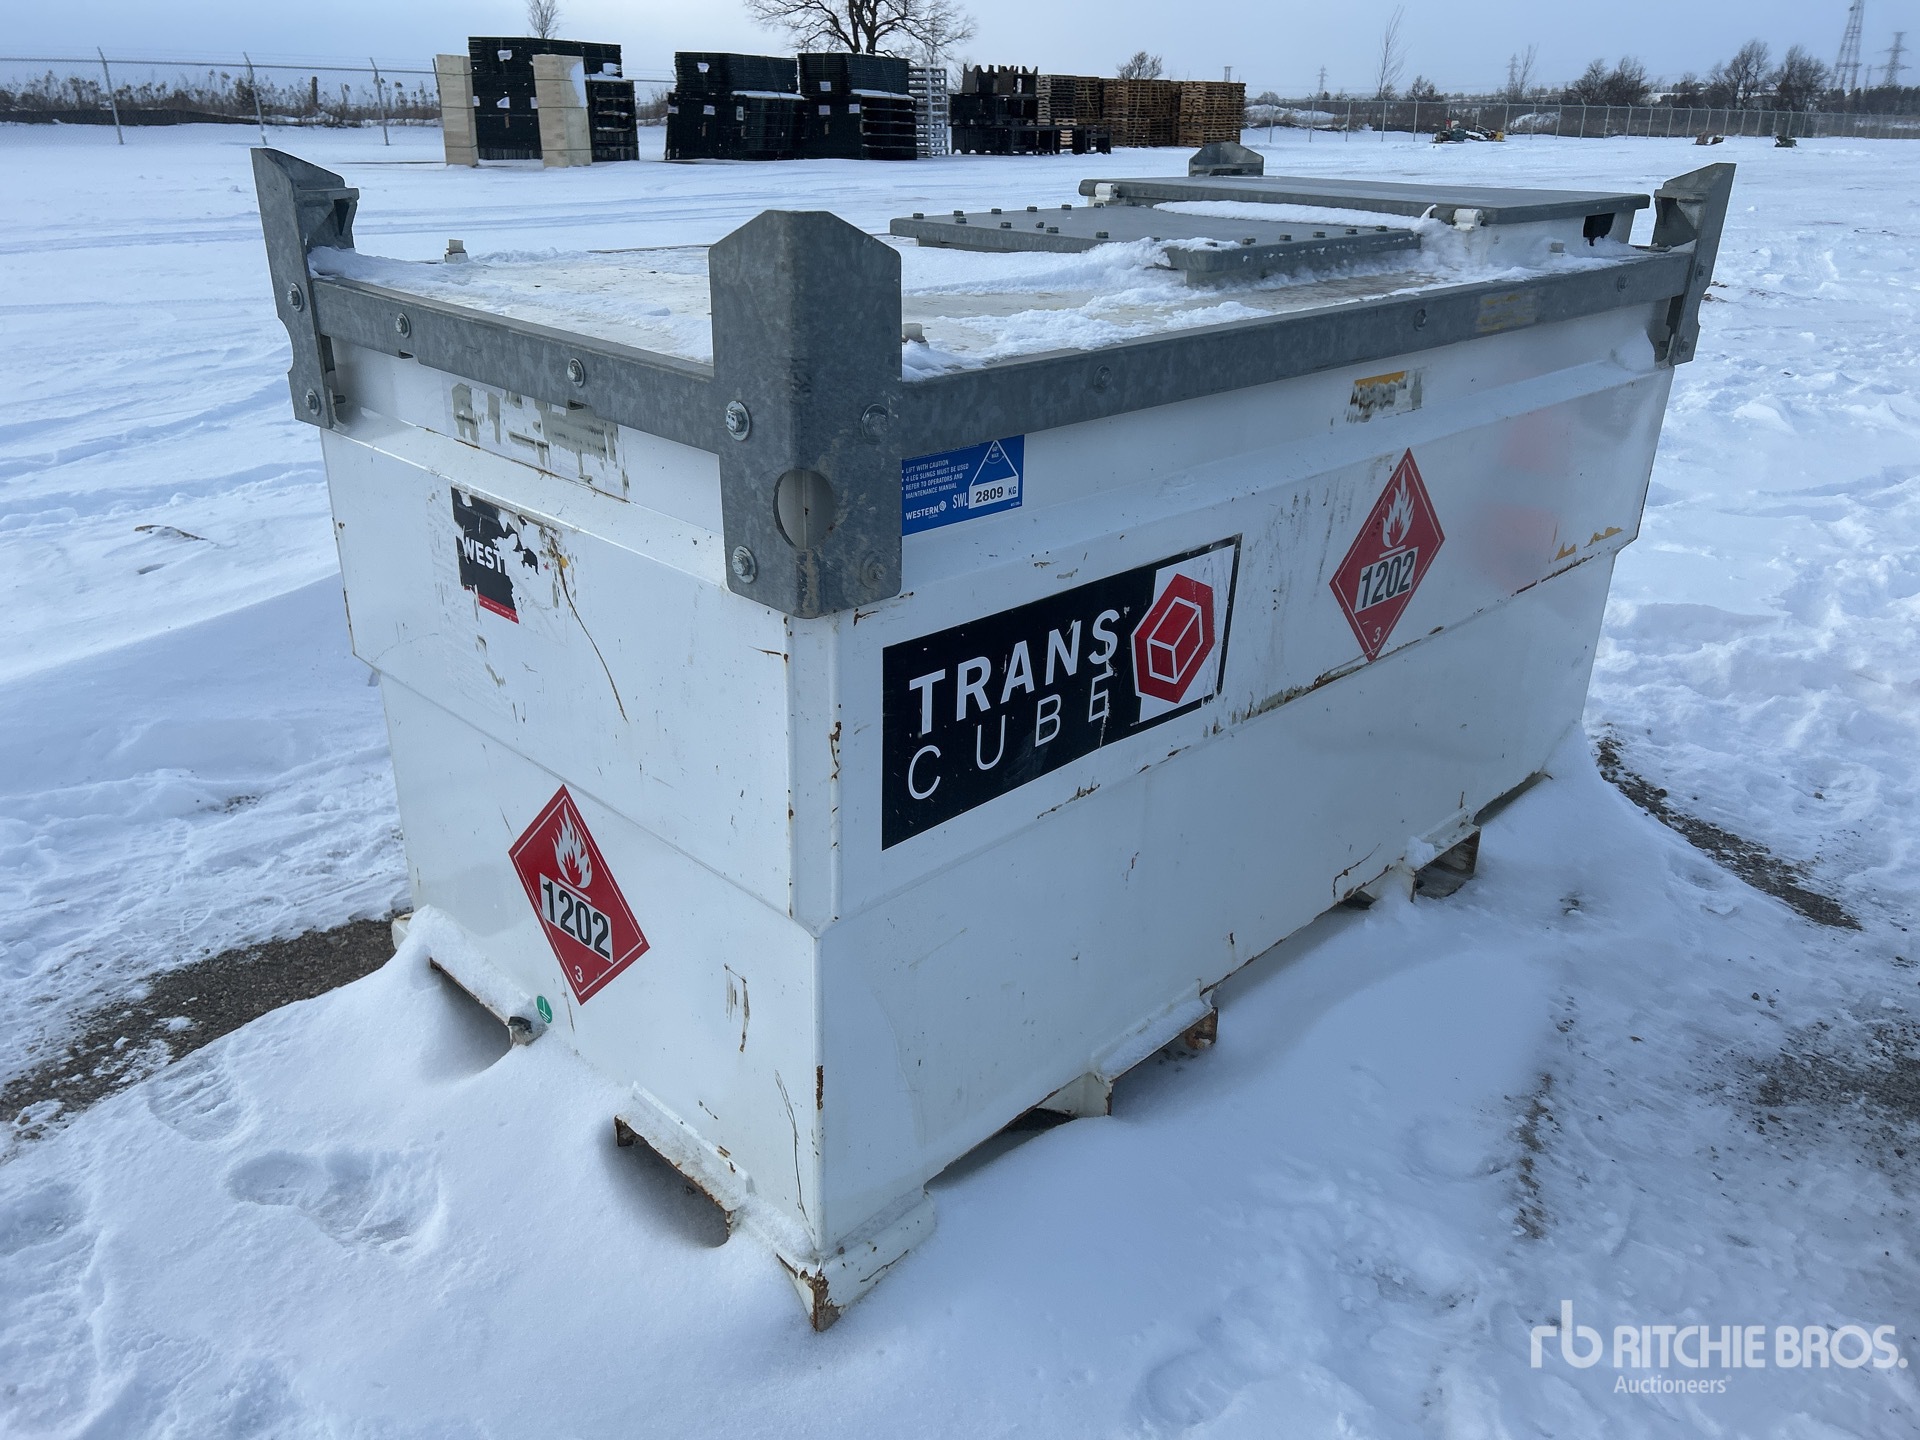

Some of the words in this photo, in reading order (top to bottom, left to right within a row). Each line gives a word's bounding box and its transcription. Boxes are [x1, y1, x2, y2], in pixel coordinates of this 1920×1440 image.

[910, 474, 919, 482] LEG
[920, 471, 936, 480] SLINGS
[937, 468, 950, 476] MUST
[957, 463, 970, 471] USED
[916, 464, 929, 472] WITH
[929, 460, 949, 468] CAUTION
[905, 482, 920, 491] REFER
[921, 480, 927, 488] TO
[928, 475, 953, 486] OPERATORS
[953, 472, 964, 481] AND
[905, 487, 938, 499] MAINTENANCE
[938, 482, 957, 492] MANUAL
[953, 492, 968, 508] SWL
[975, 486, 1004, 504] 2809
[1008, 485, 1017, 496] KG
[905, 505, 939, 520] WESTERN
[1361, 549, 1416, 609] 1202
[1373, 626, 1382, 644] 3
[909, 608, 1121, 736] TRANS
[907, 672, 1114, 801] CUBE
[542, 880, 611, 961] 1202
[574, 965, 584, 984] 3
